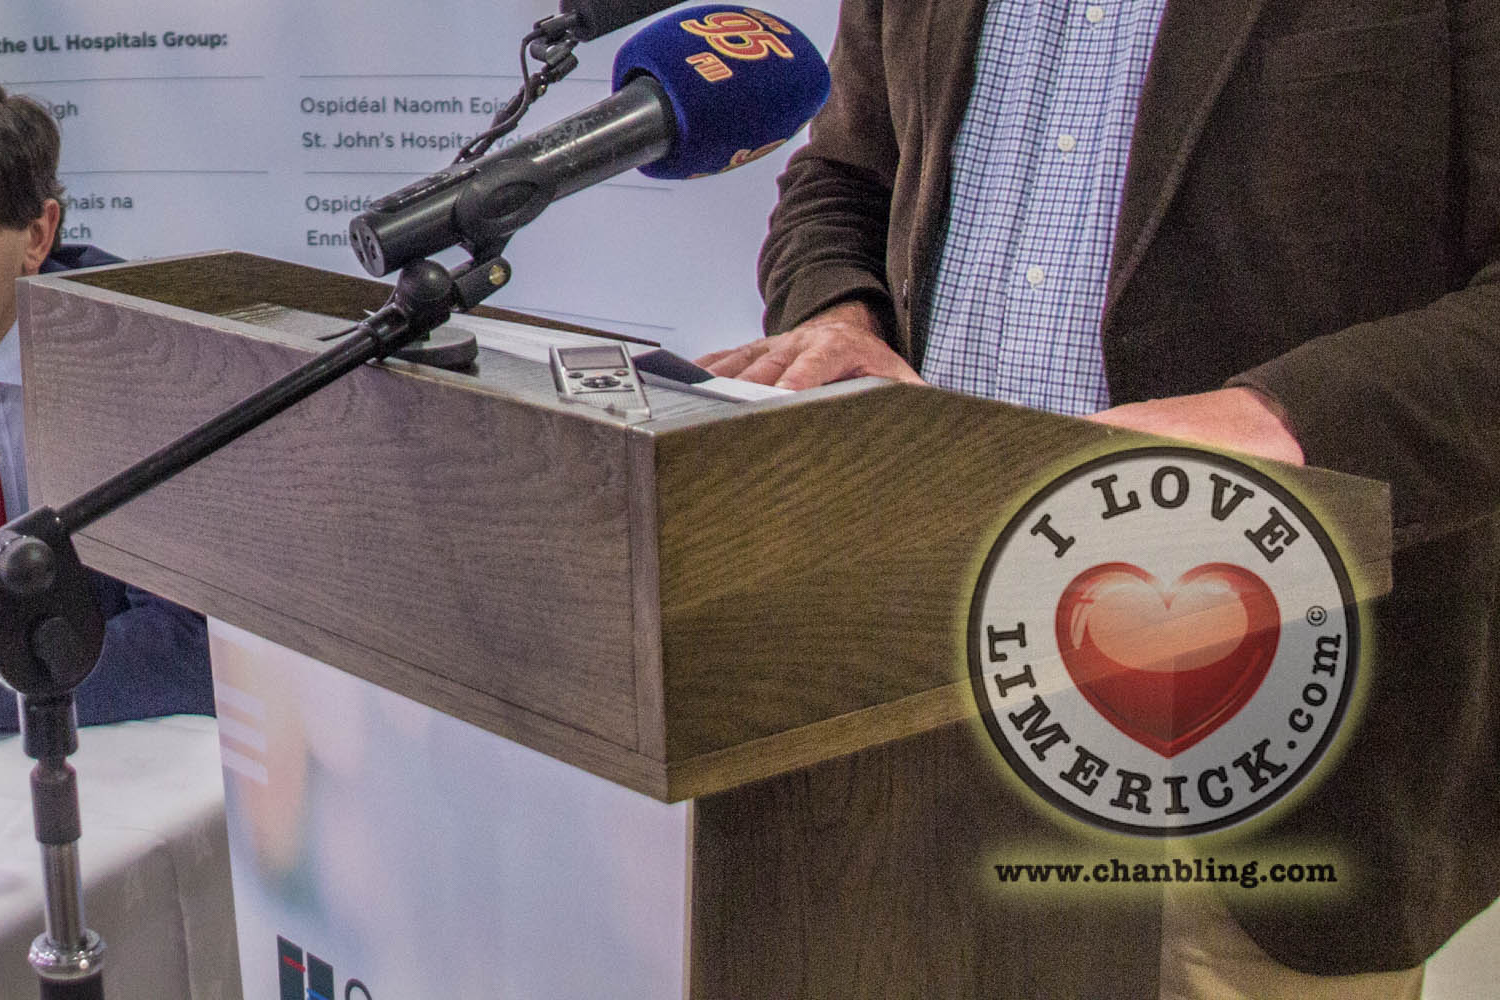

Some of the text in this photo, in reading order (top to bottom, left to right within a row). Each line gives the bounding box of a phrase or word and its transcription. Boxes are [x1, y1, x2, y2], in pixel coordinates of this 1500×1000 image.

[33, 35, 60, 52] UL
[66, 31, 157, 51] Hospitals
[163, 31, 228, 50] Group:
[680, 12, 794, 60] 95
[300, 96, 386, 115] Ospidéal
[393, 97, 463, 114] Naomh
[301, 132, 326, 148] St.
[401, 131, 478, 151] Hospita
[111, 196, 134, 209] na
[305, 194, 370, 213] Ospidé
[306, 230, 349, 246] Enni
